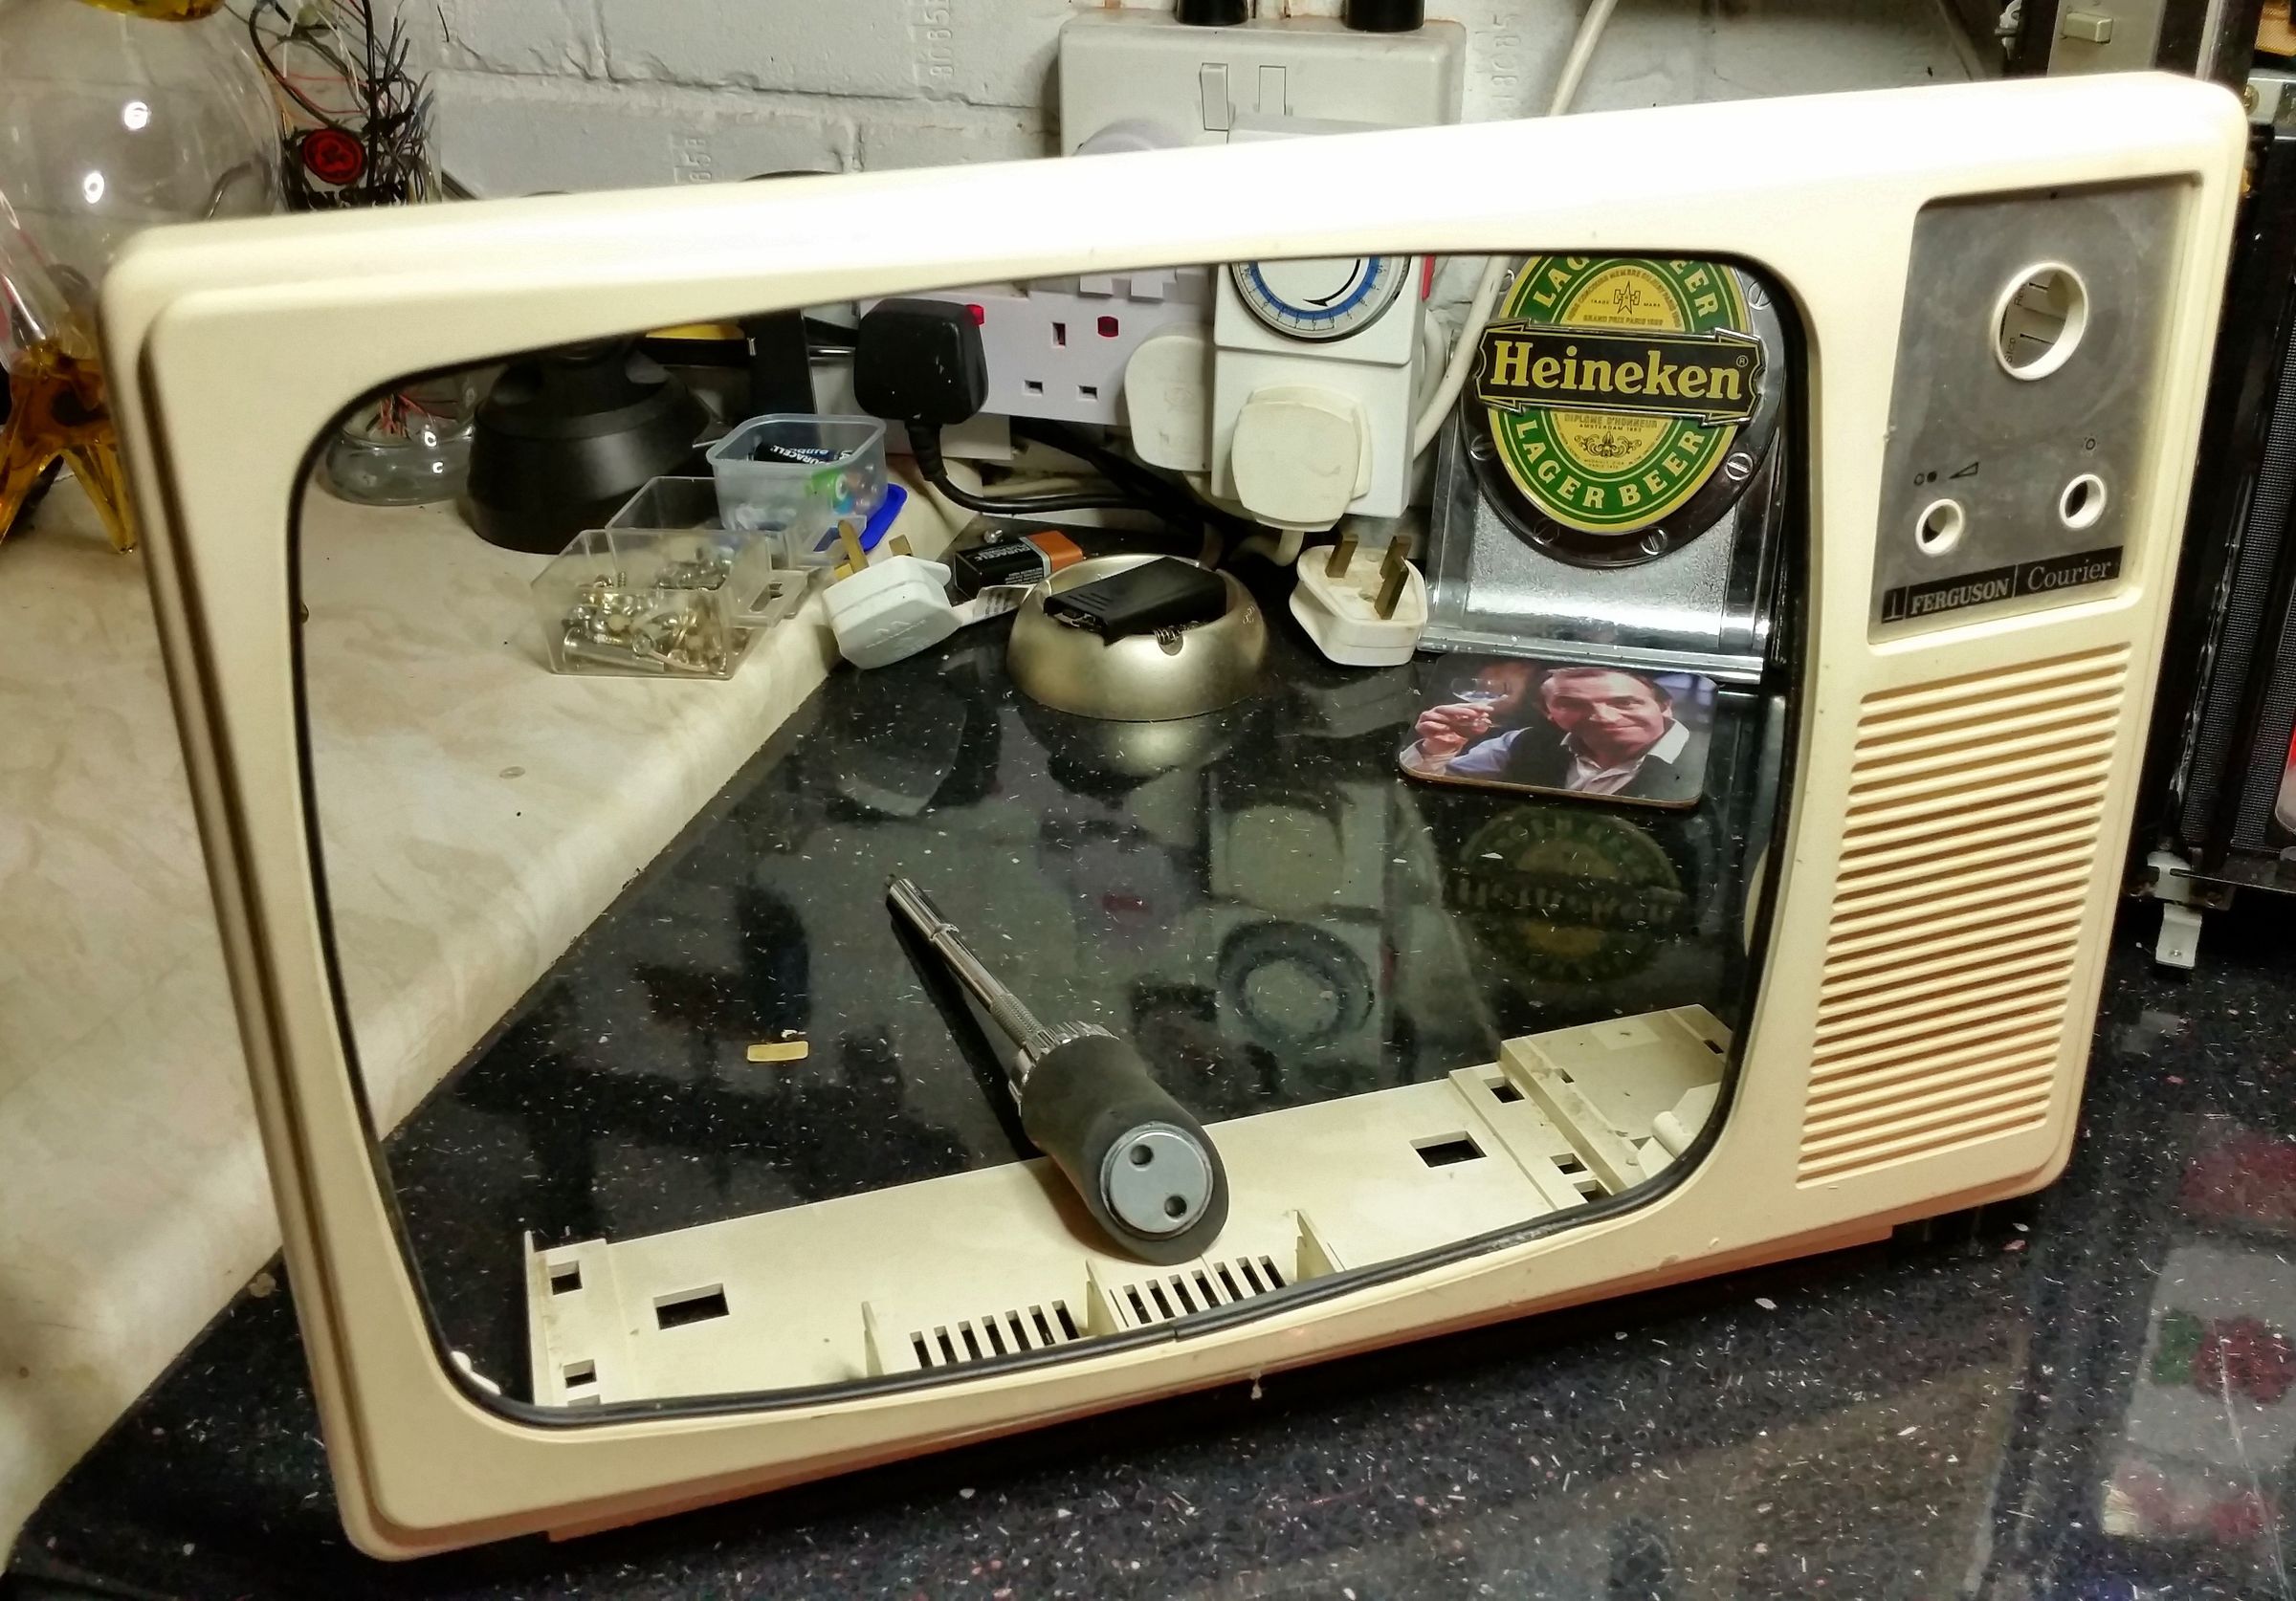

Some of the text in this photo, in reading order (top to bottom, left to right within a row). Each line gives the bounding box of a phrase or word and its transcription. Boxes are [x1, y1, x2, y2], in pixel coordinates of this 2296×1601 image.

[1490, 340, 1742, 401] Heineken
[1516, 419, 1605, 509] LAGER
[1619, 429, 1706, 508] BEER
[1910, 559, 2112, 615] FERGUSON Courier
